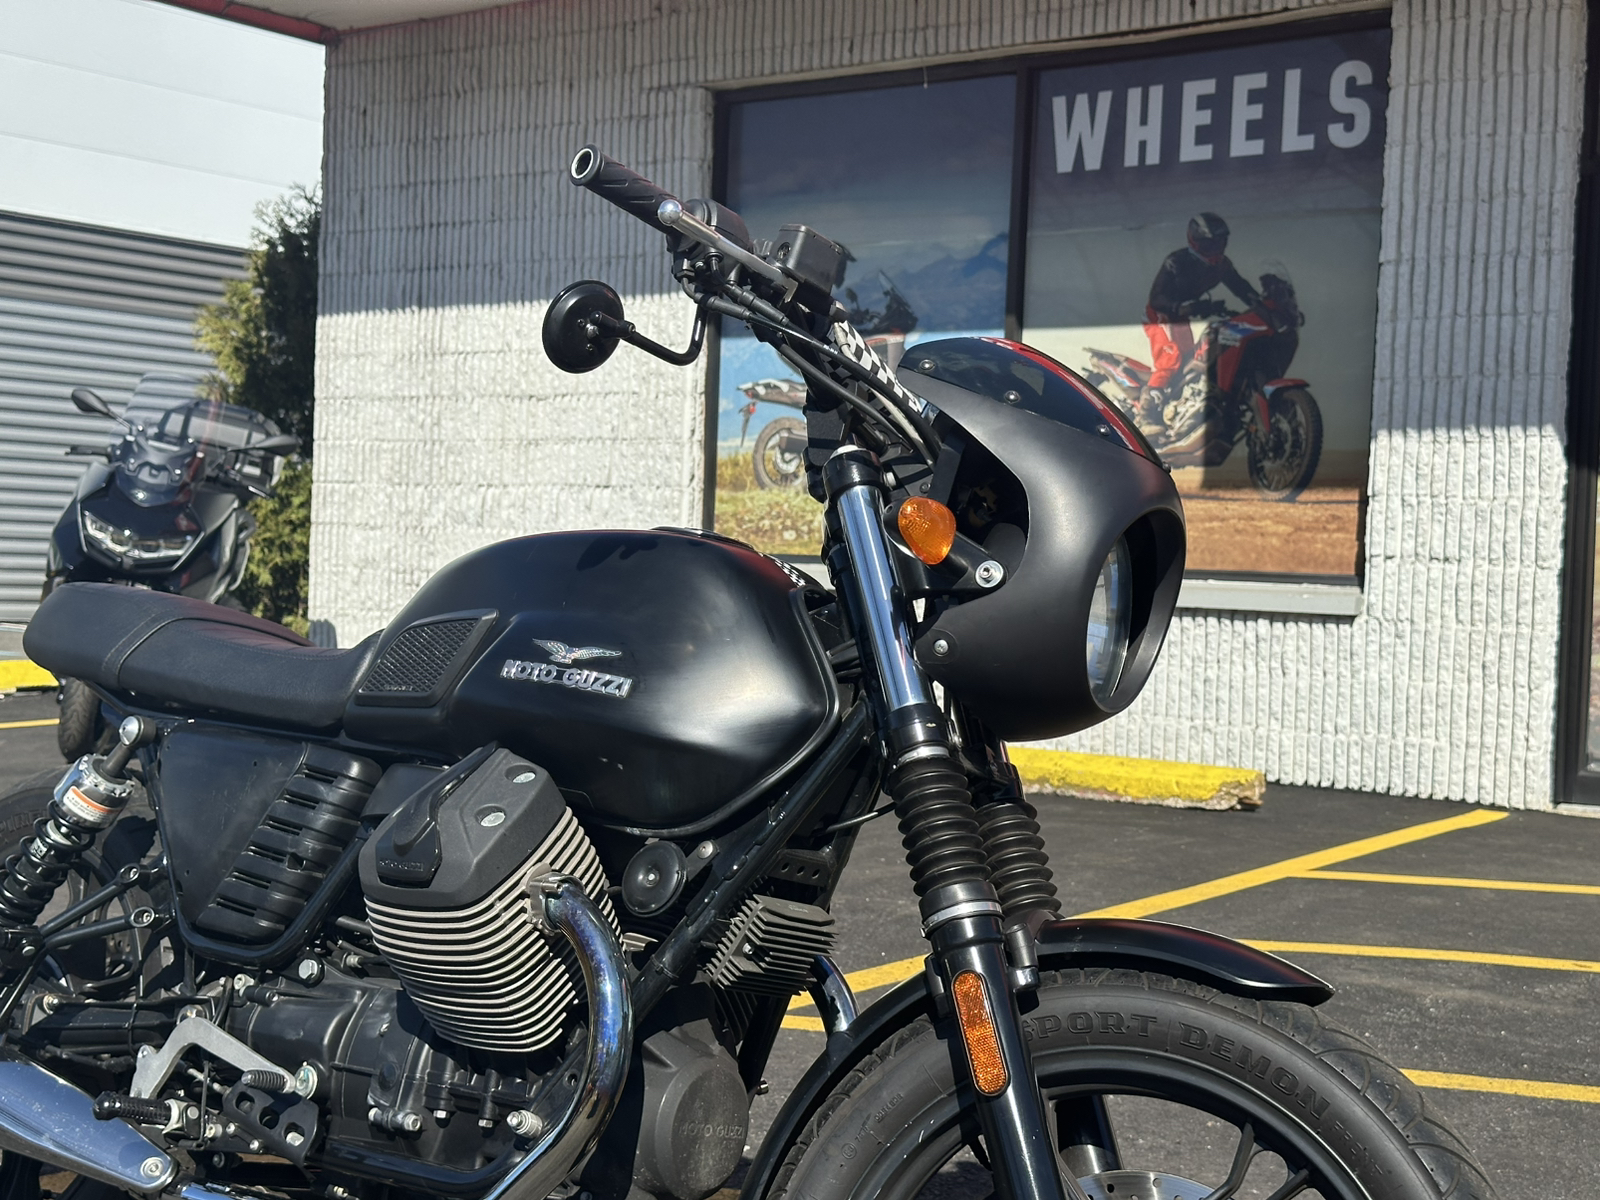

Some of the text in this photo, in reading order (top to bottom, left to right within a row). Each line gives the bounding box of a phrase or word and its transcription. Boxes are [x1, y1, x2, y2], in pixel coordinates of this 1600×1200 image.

[1051, 59, 1373, 174] WHEELS
[500, 659, 633, 698] MOTO GUZZI
[1178, 1021, 1331, 1120] DEMON
